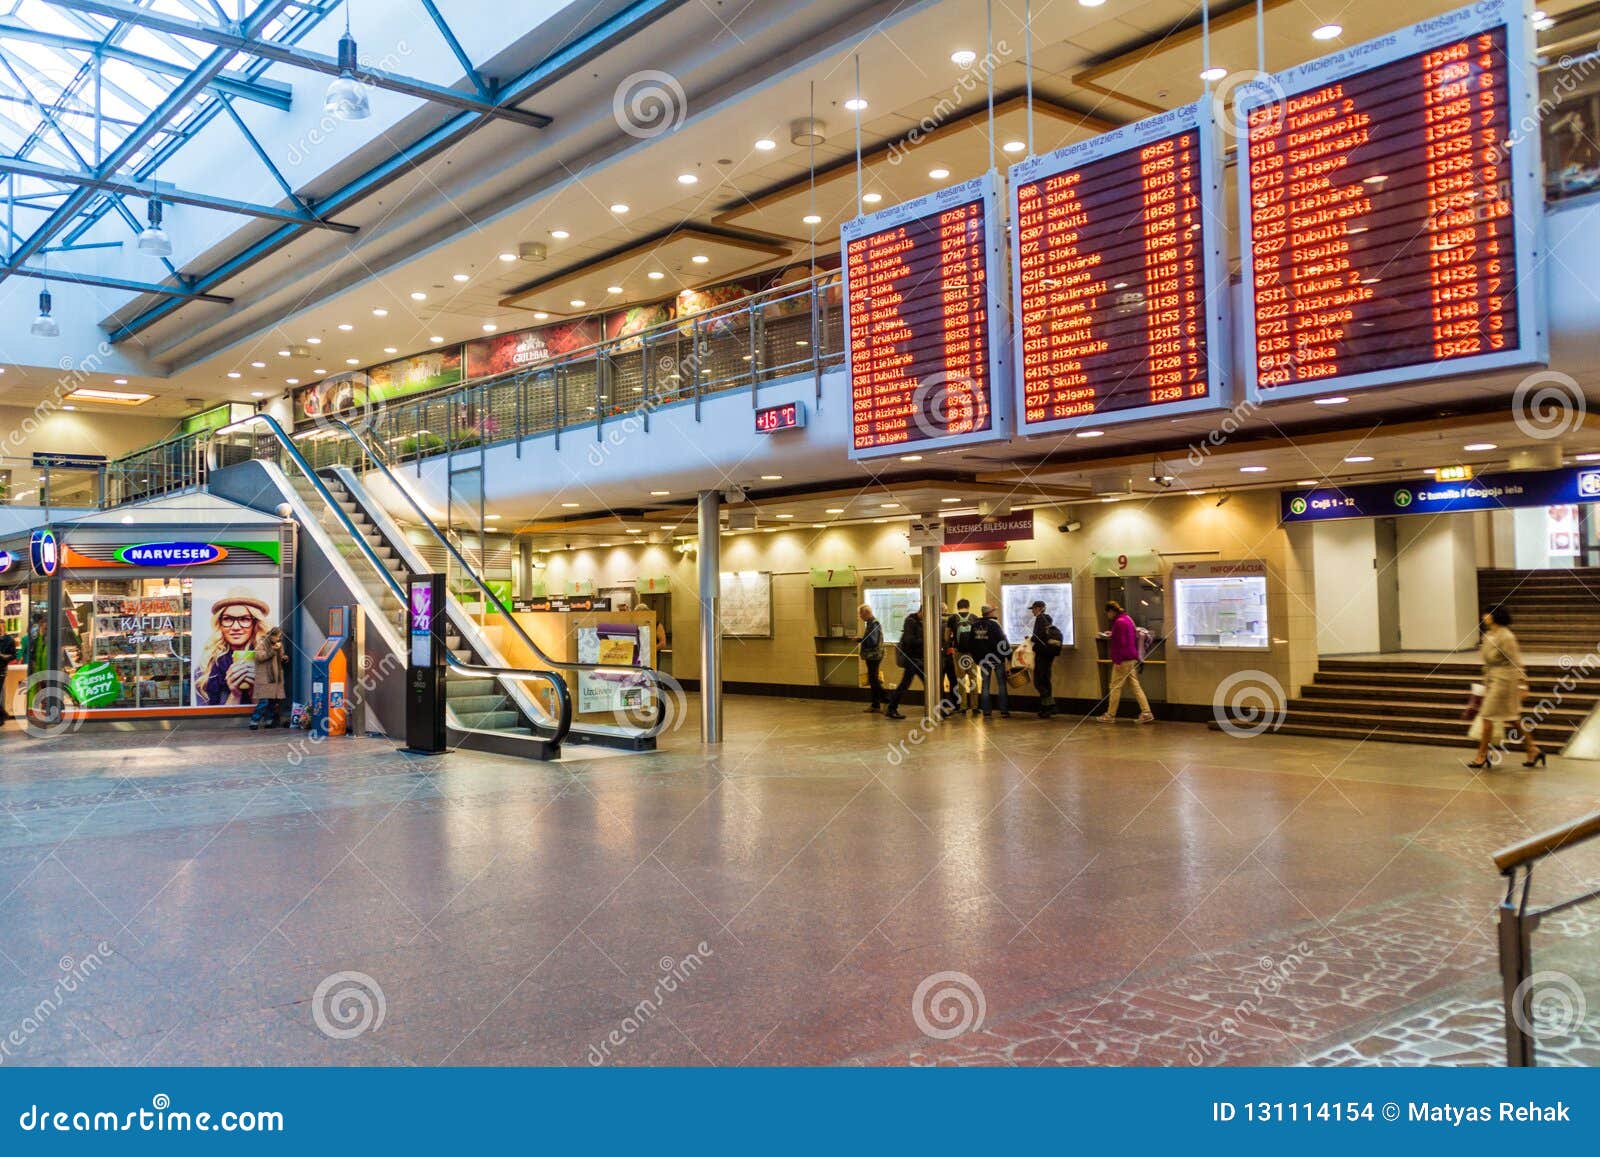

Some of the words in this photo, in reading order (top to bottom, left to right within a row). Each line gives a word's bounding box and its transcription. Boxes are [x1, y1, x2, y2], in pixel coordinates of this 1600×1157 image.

[1300, 53, 1345, 75] Vilciena
[1348, 36, 1397, 58] virziens
[1287, 87, 1342, 113] Dubulti
[1289, 108, 1335, 128] Tukums
[1343, 99, 1353, 112] 2
[1054, 142, 1088, 160] Vilciena
[1089, 130, 1123, 149] virziens
[1289, 114, 1368, 145] Daugavpils
[1290, 130, 1368, 162] Saulkrasti
[1427, 98, 1470, 122] 13:05
[1290, 156, 1346, 178] Jelgava
[1427, 118, 1471, 140] 13:29
[1046, 174, 1080, 190] Zilupe
[1141, 141, 1173, 160] 09:52
[1291, 178, 1329, 195] Sloka
[1428, 135, 1472, 158] 13:35
[1291, 186, 1363, 212] Lielvārde
[1429, 154, 1472, 176] 13:36
[1019, 198, 1042, 213] 6411
[1046, 190, 1075, 204] Sloka
[1142, 156, 1174, 174] 09:55
[1020, 212, 1043, 227] 6114
[1047, 202, 1081, 218] Skulte
[1144, 172, 1175, 190] 10:18
[1292, 199, 1370, 228] Saulkrasti
[1429, 173, 1473, 194] 13:42
[1021, 241, 1039, 254] 872
[1048, 233, 1077, 246] Valga
[1145, 203, 1175, 220] 10:38
[1184, 196, 1197, 209] 11
[1048, 213, 1087, 233] Dubulti
[1144, 187, 1175, 205] 10:23
[898, 228, 905, 238] 2
[1021, 253, 1045, 268] 6413
[1049, 247, 1077, 260] Sloka
[1145, 218, 1175, 235] 10:54
[1293, 222, 1348, 245] Dubulti
[1293, 241, 1348, 261] Sigulda
[1022, 267, 1045, 282] 6216
[1049, 255, 1100, 275] Lielvārde
[1146, 233, 1176, 250] 10:56
[1022, 281, 1046, 296] 6715
[1048, 273, 1090, 290] Jelgava
[1146, 249, 1177, 265] 11:00
[1294, 258, 1349, 278] Liepāja
[1295, 278, 1342, 294] Tukums
[1349, 271, 1360, 284] 2
[1432, 246, 1476, 266] 14:17
[1050, 281, 1106, 303] Saulkrasti
[1147, 264, 1178, 280] 11:19
[1050, 303, 1085, 317] Tukums
[1090, 298, 1096, 309] 1
[1147, 279, 1178, 295] 11:28
[1295, 288, 1372, 311] Aizkraukle
[1433, 265, 1477, 284] 14:32
[1051, 316, 1092, 331] Rēzekne
[1145, 295, 1179, 310] 11:38
[1297, 310, 1352, 328] Jelgava
[1434, 283, 1478, 302] 14:33
[1024, 337, 1048, 351] 6315
[1051, 329, 1091, 345] Dubulti
[1148, 310, 1179, 325] 11:53
[1024, 352, 1048, 365] 6218
[1052, 341, 1107, 359] Aizkraukle
[1149, 325, 1180, 341] 12:15
[1295, 347, 1336, 362] Sloka
[1436, 321, 1479, 338] 14:52
[1297, 329, 1343, 346] Skulte
[1025, 365, 1049, 379] 6415
[1051, 361, 1081, 375] Sloka
[1149, 340, 1180, 356] 12:16
[1025, 380, 1049, 392] 6126
[1053, 374, 1087, 387] Skulte
[1150, 356, 1181, 371] 12:20
[1298, 364, 1336, 378] Sloka
[1436, 339, 1480, 357] 15:22
[904, 391, 911, 401] 2
[1026, 394, 1049, 406] 6717
[1054, 388, 1094, 401] Jelgava
[1151, 371, 1181, 386] 12:30
[1054, 402, 1094, 416] Sigulda
[1151, 387, 1182, 401] 12:30
[1191, 383, 1205, 395] 10
[757, 411, 777, 429] +15
[1344, 497, 1355, 506] 12
[1418, 492, 1426, 501] C
[1504, 485, 1523, 494] iela
[946, 523, 983, 534] IEKŠZEMES
[1008, 520, 1032, 529] KASES
[131, 549, 210, 560] NARVESEN
[1117, 555, 1128, 570] 9
[827, 569, 834, 582] 7
[120, 616, 174, 631] KAFIJA
